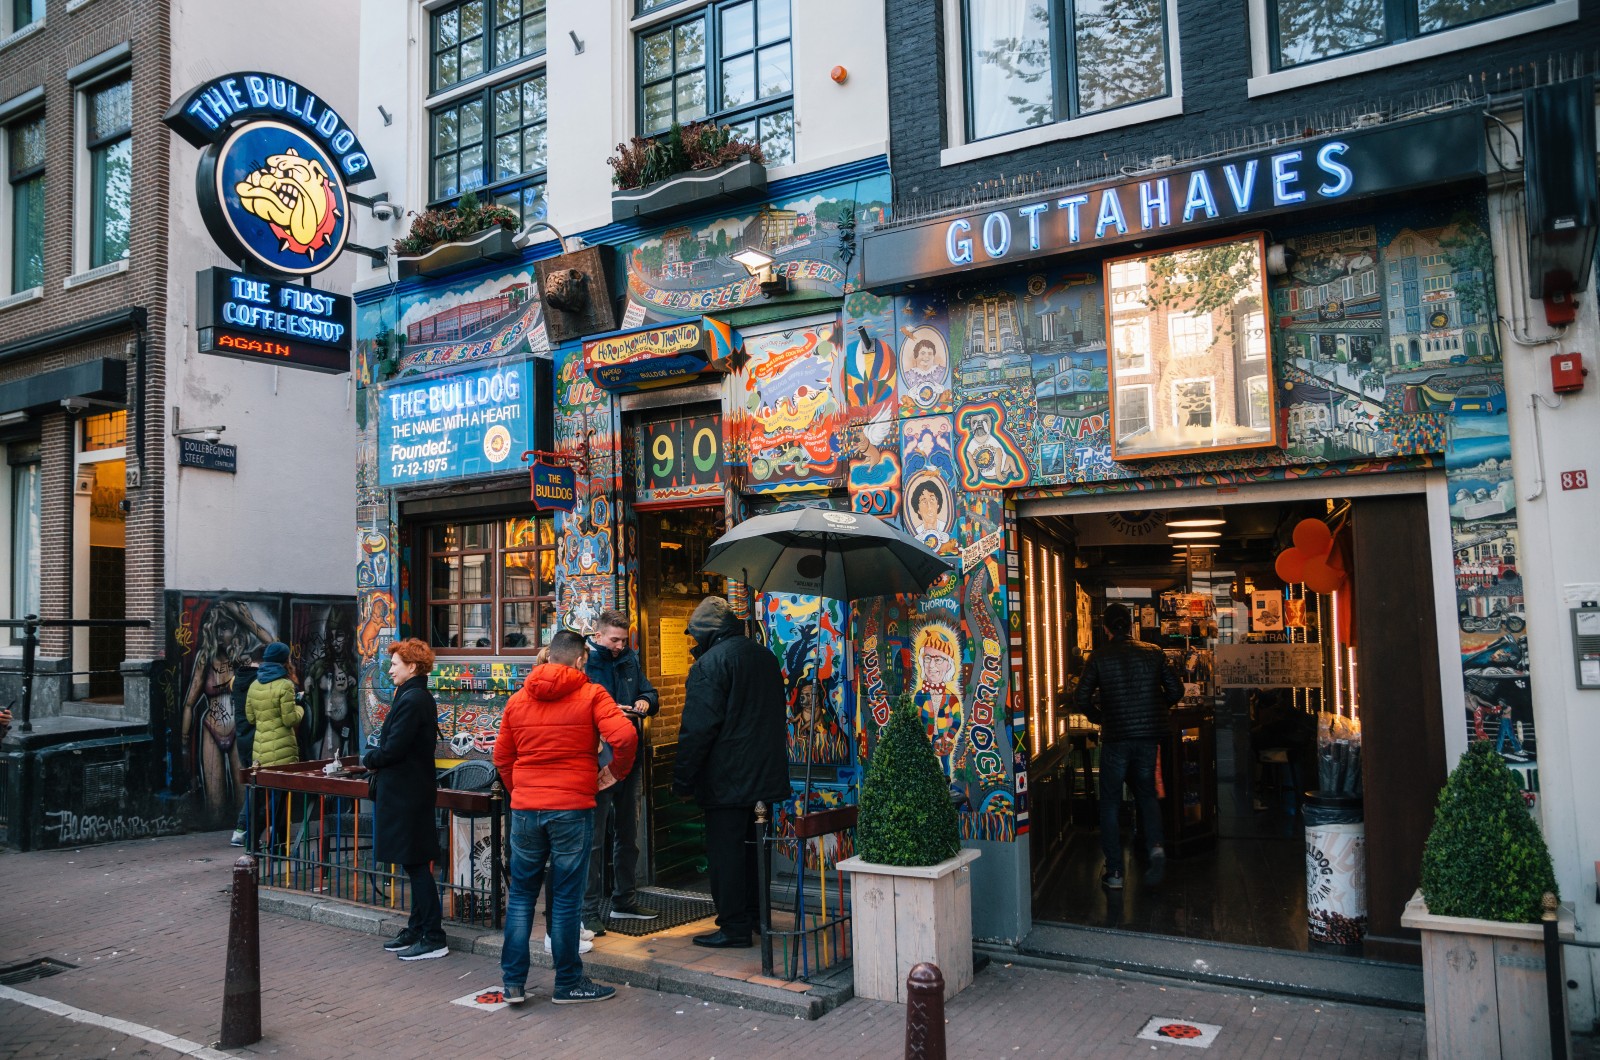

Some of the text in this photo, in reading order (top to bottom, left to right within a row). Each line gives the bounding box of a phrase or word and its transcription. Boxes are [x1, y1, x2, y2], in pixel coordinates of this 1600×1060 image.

[189, 75, 369, 175] THE BULLDOG
[946, 141, 1353, 266] GOTTAHAVES
[645, 261, 837, 308] BULLDOG LEIDEPLEIN
[230, 276, 335, 317] THE FIRST
[223, 301, 345, 343] COFFEESHOP
[218, 335, 290, 357] AGAIN
[411, 349, 441, 363] FIRST
[472, 347, 480, 357] &
[389, 371, 520, 421] THE BULLDOG
[561, 381, 602, 406] JUICE
[392, 404, 521, 439] THE NAME WITH A HEART!
[184, 441, 235, 457] DOLLEBEGIJNEN
[184, 453, 205, 464] STEEG
[391, 439, 452, 462] Founded:
[391, 458, 448, 478] 17-12-1975
[548, 473, 562, 485] THE
[1563, 471, 1587, 489] 88
[535, 484, 573, 500] BULLDOG
[860, 491, 887, 513] 90
[1106, 510, 1164, 537] AMSTERDAM
[920, 598, 959, 613] THORNTON
[1250, 632, 1304, 643] ENTRANCE
[863, 635, 890, 728] BULLD
[969, 637, 1002, 775] BULLDOG
[1307, 843, 1333, 875] LLDOG
[1308, 916, 1326, 928] OFFEE
